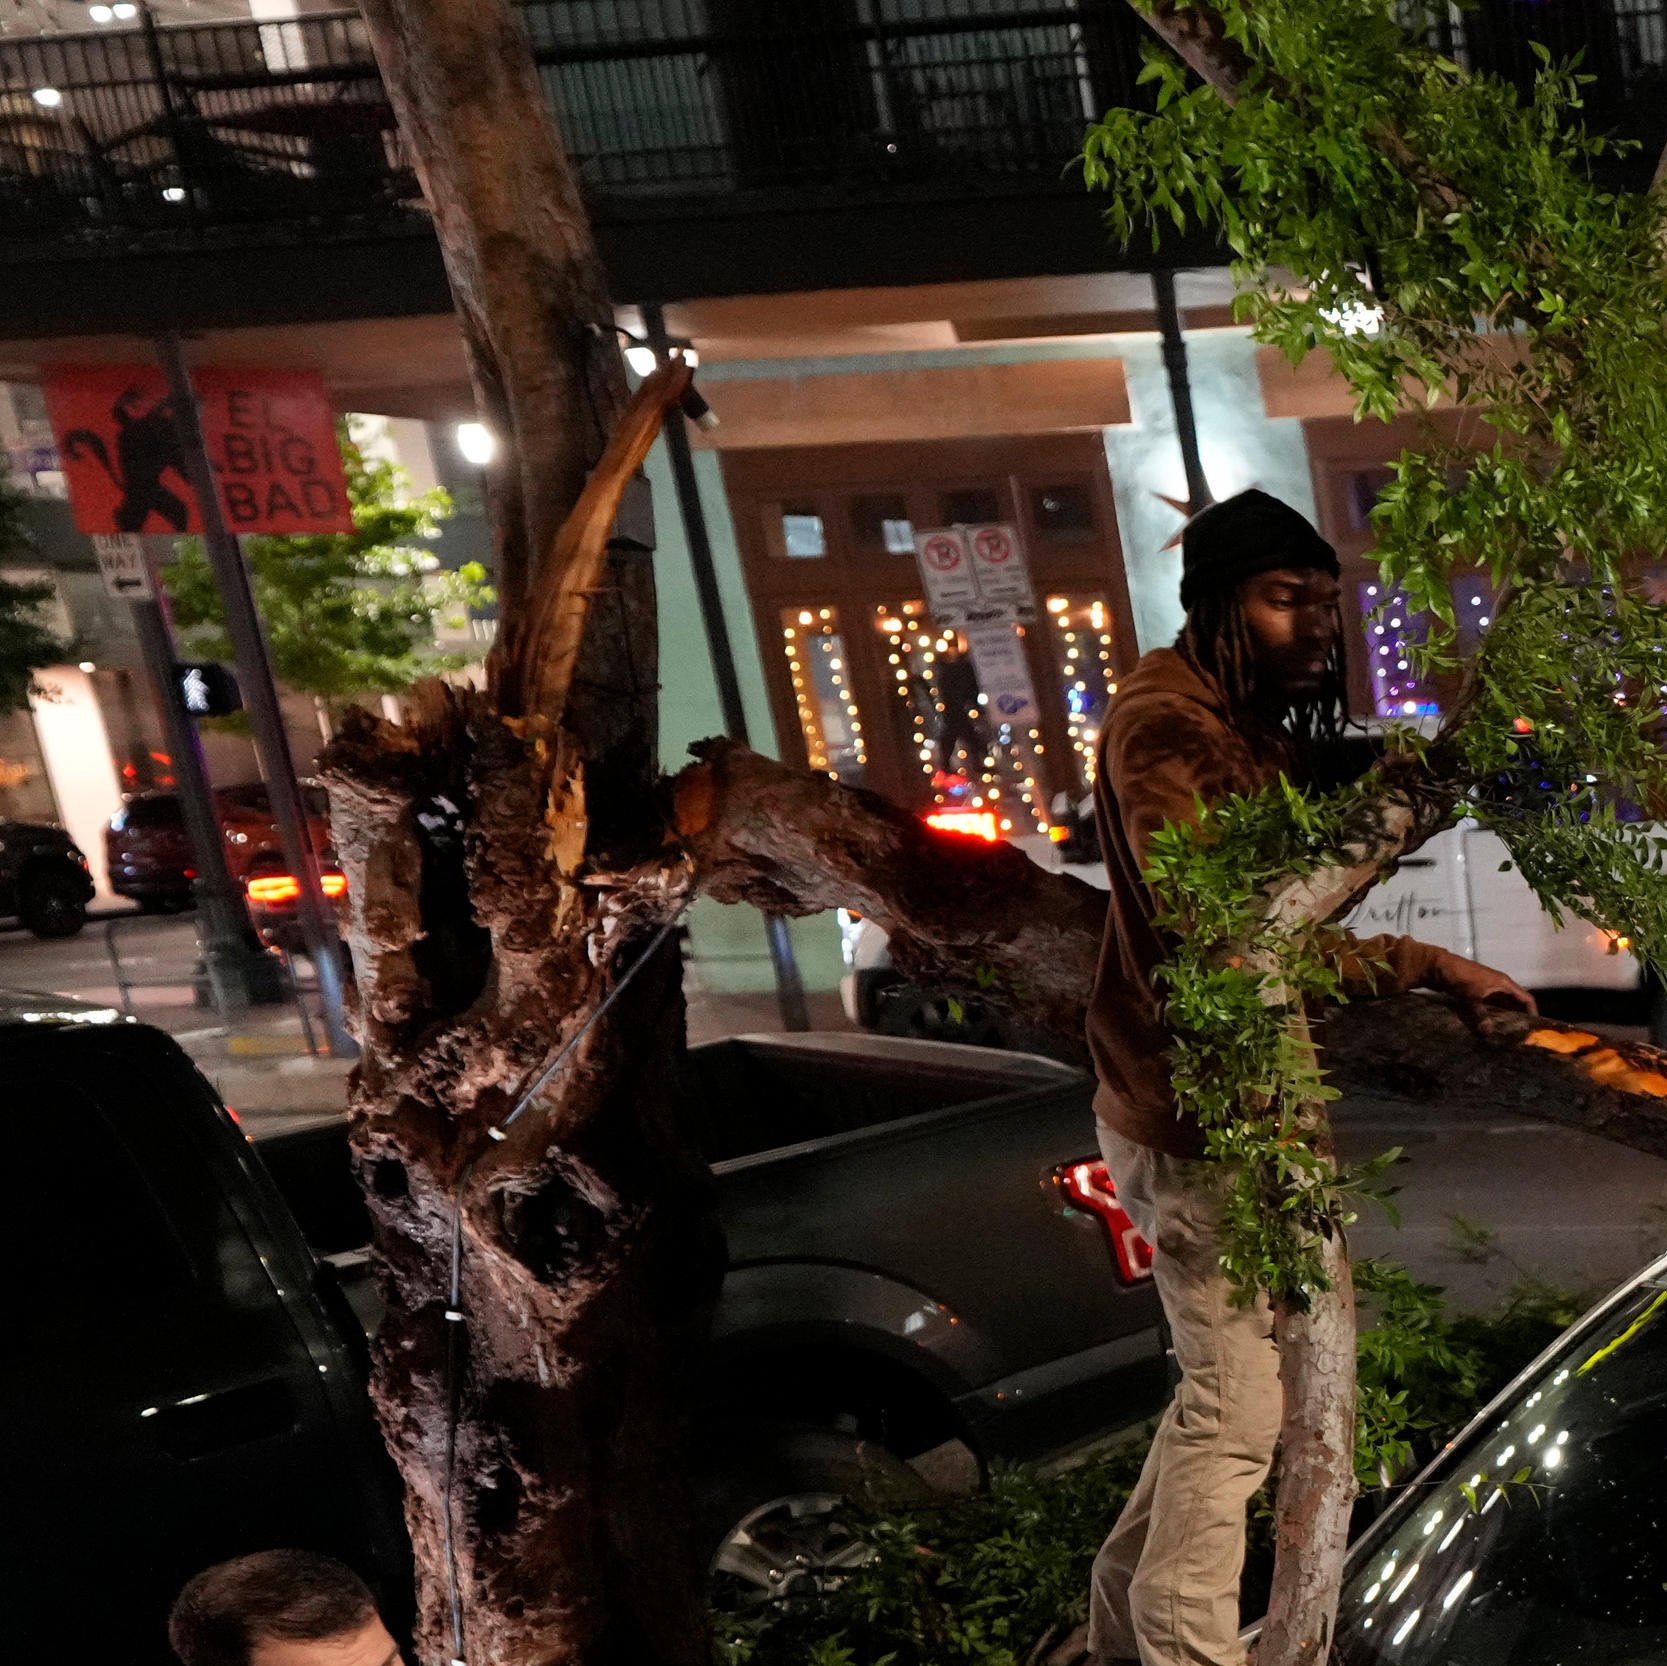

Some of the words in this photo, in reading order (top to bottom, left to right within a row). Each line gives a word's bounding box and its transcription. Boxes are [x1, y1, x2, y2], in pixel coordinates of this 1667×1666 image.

[227, 389, 289, 433] EL
[223, 433, 317, 476] BIG
[222, 479, 338, 523] BAD
